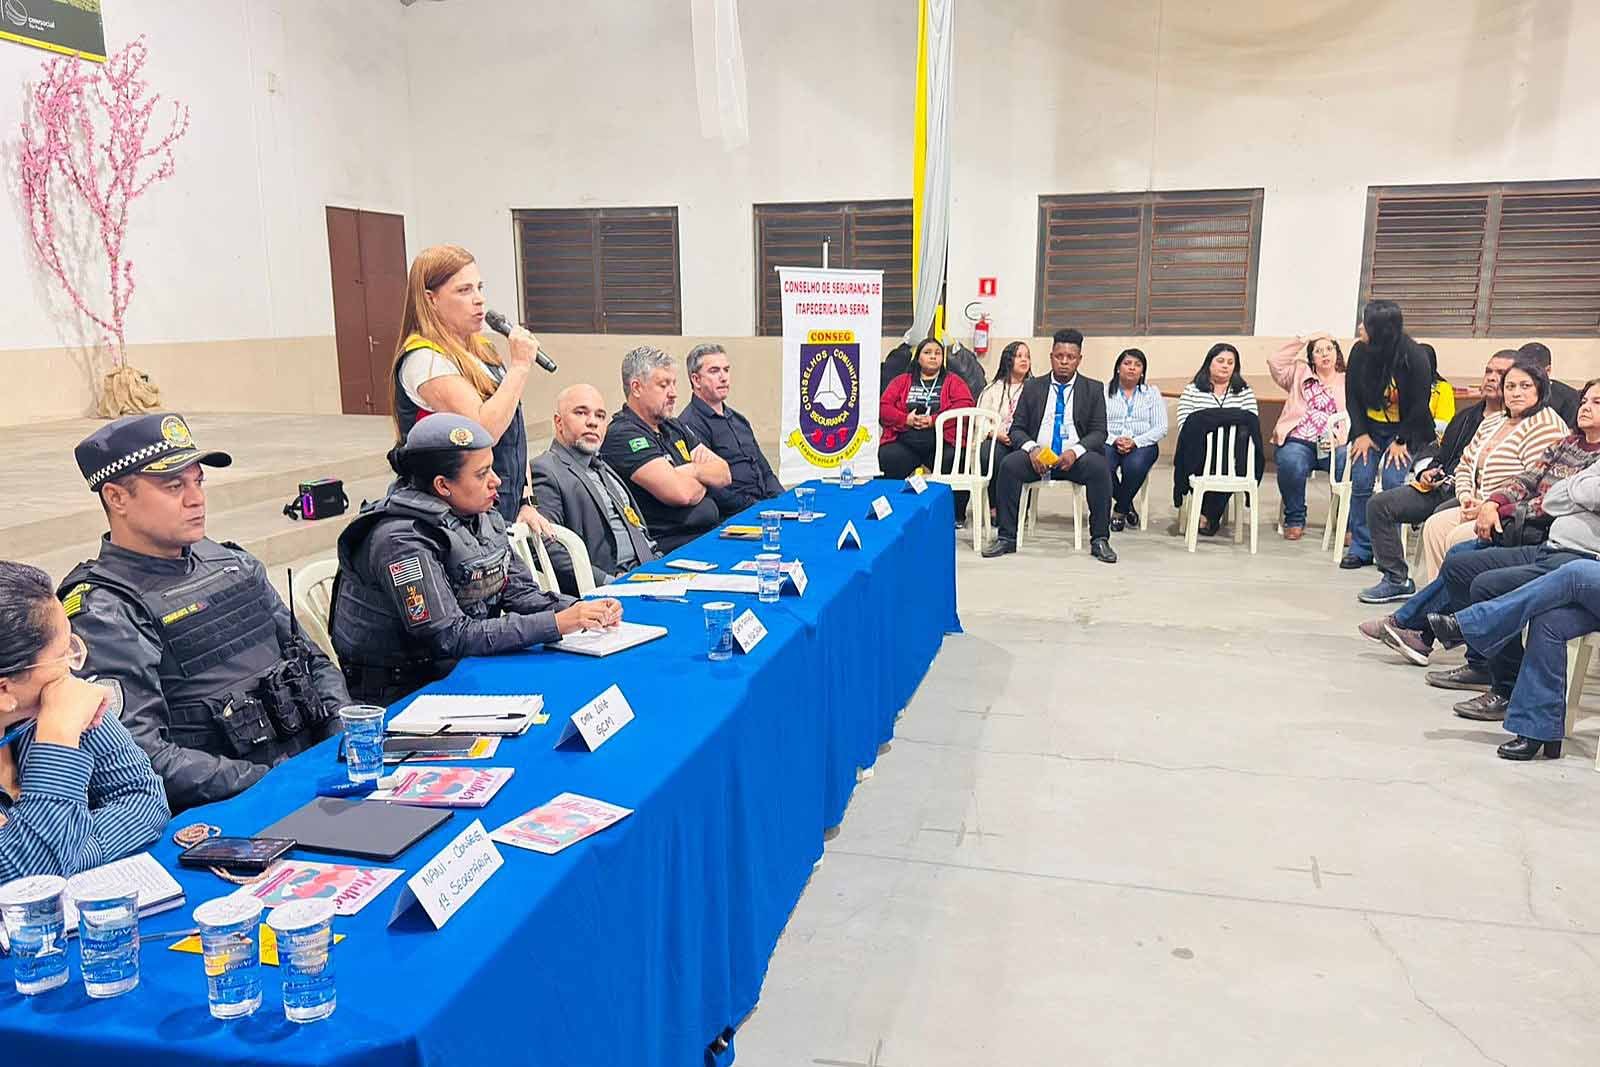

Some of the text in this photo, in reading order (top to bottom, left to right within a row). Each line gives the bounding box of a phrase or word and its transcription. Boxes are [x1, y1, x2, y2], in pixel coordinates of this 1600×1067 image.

[784, 281, 880, 295] CONSELHO DE SEGURANÇA DE
[796, 303, 869, 315] ITAPECERICA DA SERRA
[810, 332, 851, 342] CONSEG
[801, 350, 828, 411] CONSELHOS
[421, 862, 447, 888] NANI
[334, 869, 377, 910] Mulhe
